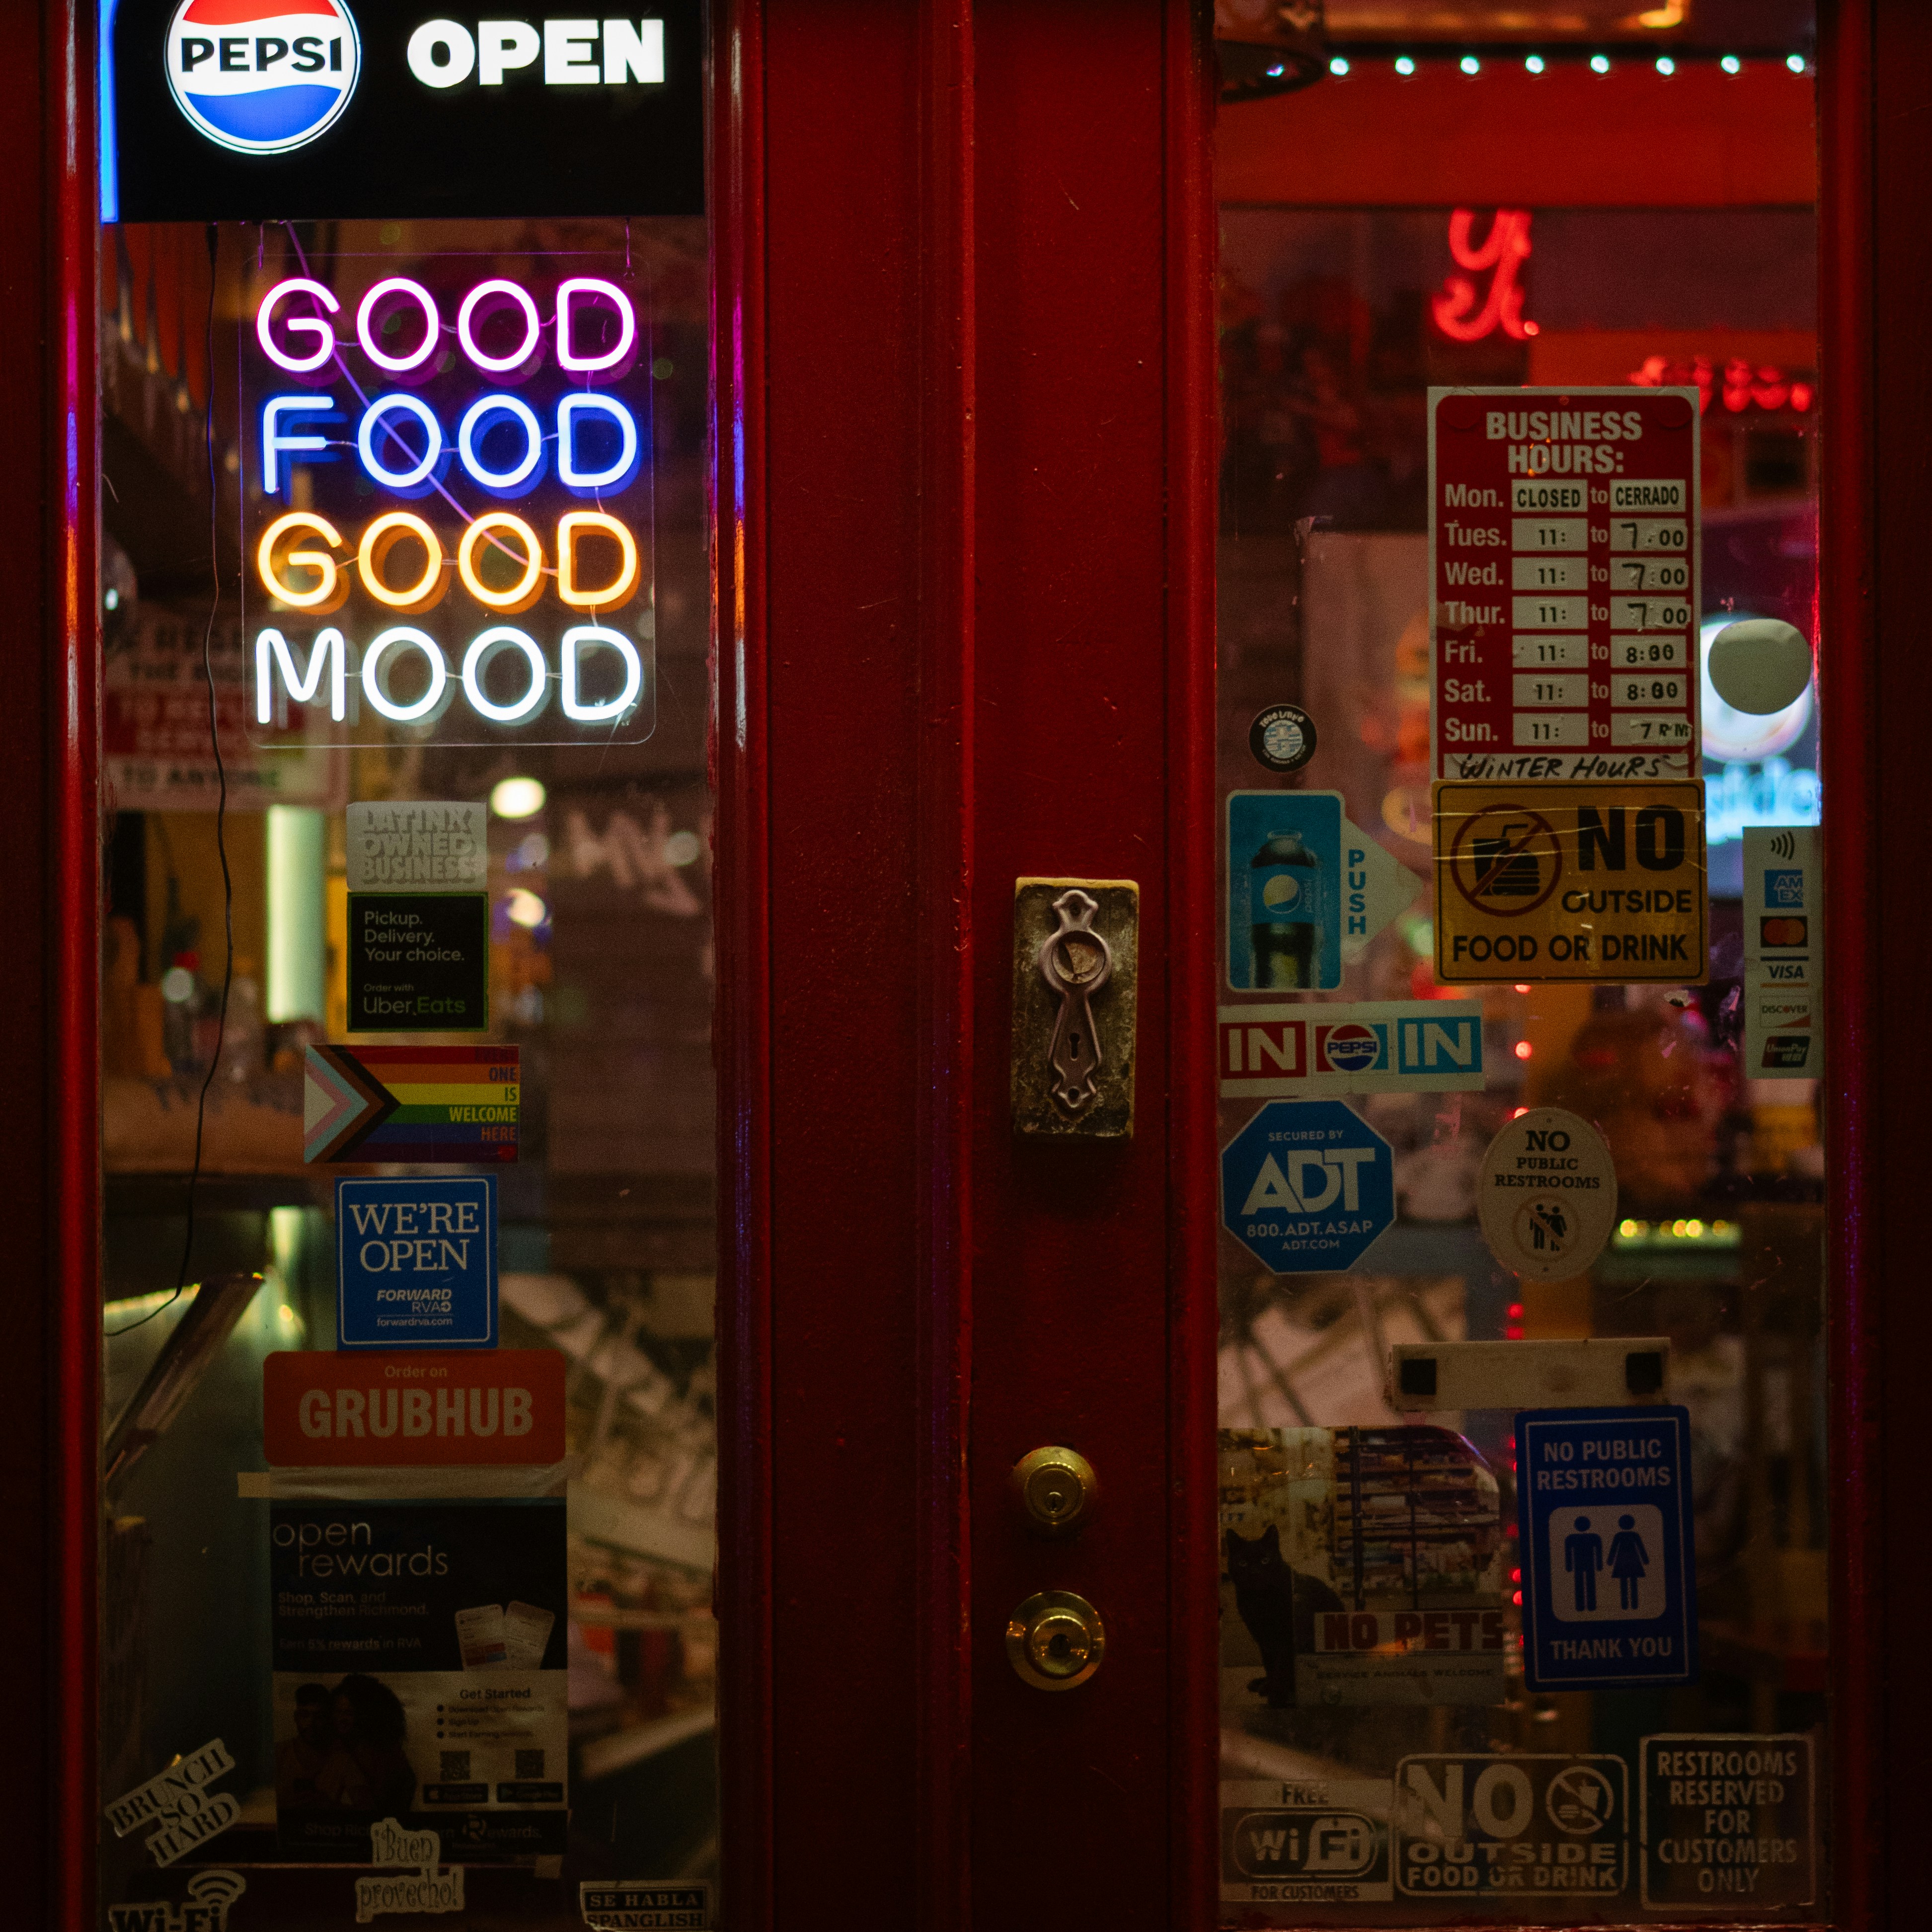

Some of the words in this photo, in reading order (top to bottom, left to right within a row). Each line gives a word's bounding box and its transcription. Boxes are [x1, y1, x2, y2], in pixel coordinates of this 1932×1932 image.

[181, 37, 343, 72] PEPSI
[407, 19, 666, 88] OPEN
[255, 278, 635, 373] GOOD
[1486, 411, 1643, 440] BUSINESS
[263, 393, 637, 494] FOOD
[1508, 445, 1624, 474] HOURS:
[1444, 483, 1504, 508] Mon.
[1517, 488, 1581, 508] CLOSED
[1591, 487, 1609, 504] to
[1616, 486, 1679, 506] CERRADO
[1444, 522, 1507, 546] Tues.
[1539, 529, 1565, 545] 11:
[1590, 527, 1609, 543] to
[257, 511, 637, 607] GOOD
[1444, 561, 1504, 586] Wed.
[1538, 568, 1565, 585] 11:
[1590, 565, 1609, 582] to
[1444, 601, 1505, 624] Thur.
[1539, 607, 1566, 622] 11:
[1591, 604, 1609, 620] to
[1444, 640, 1483, 663] Fri.
[1538, 645, 1565, 661] 11:
[1591, 643, 1609, 660] to
[255, 625, 641, 724] MOOD
[1444, 679, 1491, 703] Sat.
[1536, 684, 1563, 700] 11:
[1591, 682, 1609, 699] to
[1444, 718, 1499, 742] Sun.
[1532, 723, 1559, 739] 11:
[1591, 721, 1609, 738] to
[364, 833, 476, 857] OWNED
[1578, 804, 1685, 871] NO
[362, 856, 476, 884] BUSINESS
[1348, 849, 1366, 935] PUSH
[1561, 890, 1692, 914] OUTSIDE
[364, 911, 423, 928] Pickup.
[364, 928, 435, 946] Delivery.
[1453, 935, 1538, 962] FOOD
[1548, 935, 1589, 961] OR
[1602, 934, 1688, 961] DRINK
[365, 947, 402, 962] Your
[405, 946, 465, 962] choice.
[1769, 966, 1804, 979] VISA
[364, 983, 392, 993] Order
[394, 983, 414, 993] with
[363, 996, 412, 1014] Uber
[417, 996, 467, 1014] Eats
[1762, 1005, 1807, 1013] DISCOVER
[1228, 1027, 1297, 1072] IN
[1327, 1041, 1377, 1054] PEPSI
[1404, 1021, 1472, 1067] IN
[489, 1067, 517, 1082] ONE
[504, 1087, 517, 1102] IS
[448, 1106, 517, 1122] WELCOME
[480, 1126, 517, 1142] HERE
[1267, 1130, 1325, 1142] SECURED
[1328, 1130, 1344, 1140] BY
[1525, 1130, 1570, 1152] NO
[1516, 1157, 1579, 1170] PUBLIC
[1240, 1147, 1376, 1215] ADT
[1494, 1174, 1600, 1189] RESTROOMS
[348, 1202, 480, 1236] WE'RE
[1246, 1220, 1374, 1237] 800.ADT.ASAP
[359, 1238, 470, 1273] OPEN
[376, 1288, 453, 1302] FORWARD
[385, 1365, 426, 1379] Order
[429, 1366, 448, 1378] on
[299, 1387, 534, 1438] GRUBHUB
[1544, 1441, 1574, 1463] NO
[1582, 1439, 1662, 1461] PUBLIC
[1537, 1466, 1672, 1491] RESTROOMS
[272, 1521, 372, 1553] open
[298, 1545, 449, 1578] rewards
[360, 1591, 386, 1604] and
[278, 1605, 356, 1620] Strengthen
[359, 1603, 429, 1616] Richmond.
[383, 1637, 394, 1649] in
[396, 1637, 422, 1649] RVA
[1323, 1614, 1379, 1650] NO
[1395, 1612, 1503, 1650] PETS
[1549, 1638, 1623, 1661] THANK
[1629, 1636, 1674, 1658] YOU
[459, 1690, 483, 1700] Get
[485, 1688, 531, 1699] Started
[1656, 1750, 1798, 1777] RESTROOMS
[112, 1748, 227, 1830] BRUNCH
[1669, 1779, 1786, 1806] RESERVED
[160, 1792, 201, 1828] SO
[1406, 1764, 1534, 1839] NO
[153, 1802, 233, 1861] HARD
[304, 1823, 339, 1837] Shop
[1704, 1808, 1751, 1835] FOR
[1407, 1842, 1617, 1865] OUTSIDE
[1657, 1837, 1798, 1864] CUSTOMERS
[1406, 1865, 1479, 1888] FOOD
[1488, 1865, 1525, 1888] OR
[1534, 1865, 1618, 1887] DRINK
[1697, 1867, 1760, 1893] ONLY
[589, 1894, 617, 1908] SE
[624, 1893, 699, 1907] HABLA
[1251, 1885, 1278, 1901] FOR
[1281, 1884, 1360, 1900] CUSTOMERS
[111, 1906, 220, 1932] Wi-Fi
[586, 1914, 703, 1927] SPANGLISH
